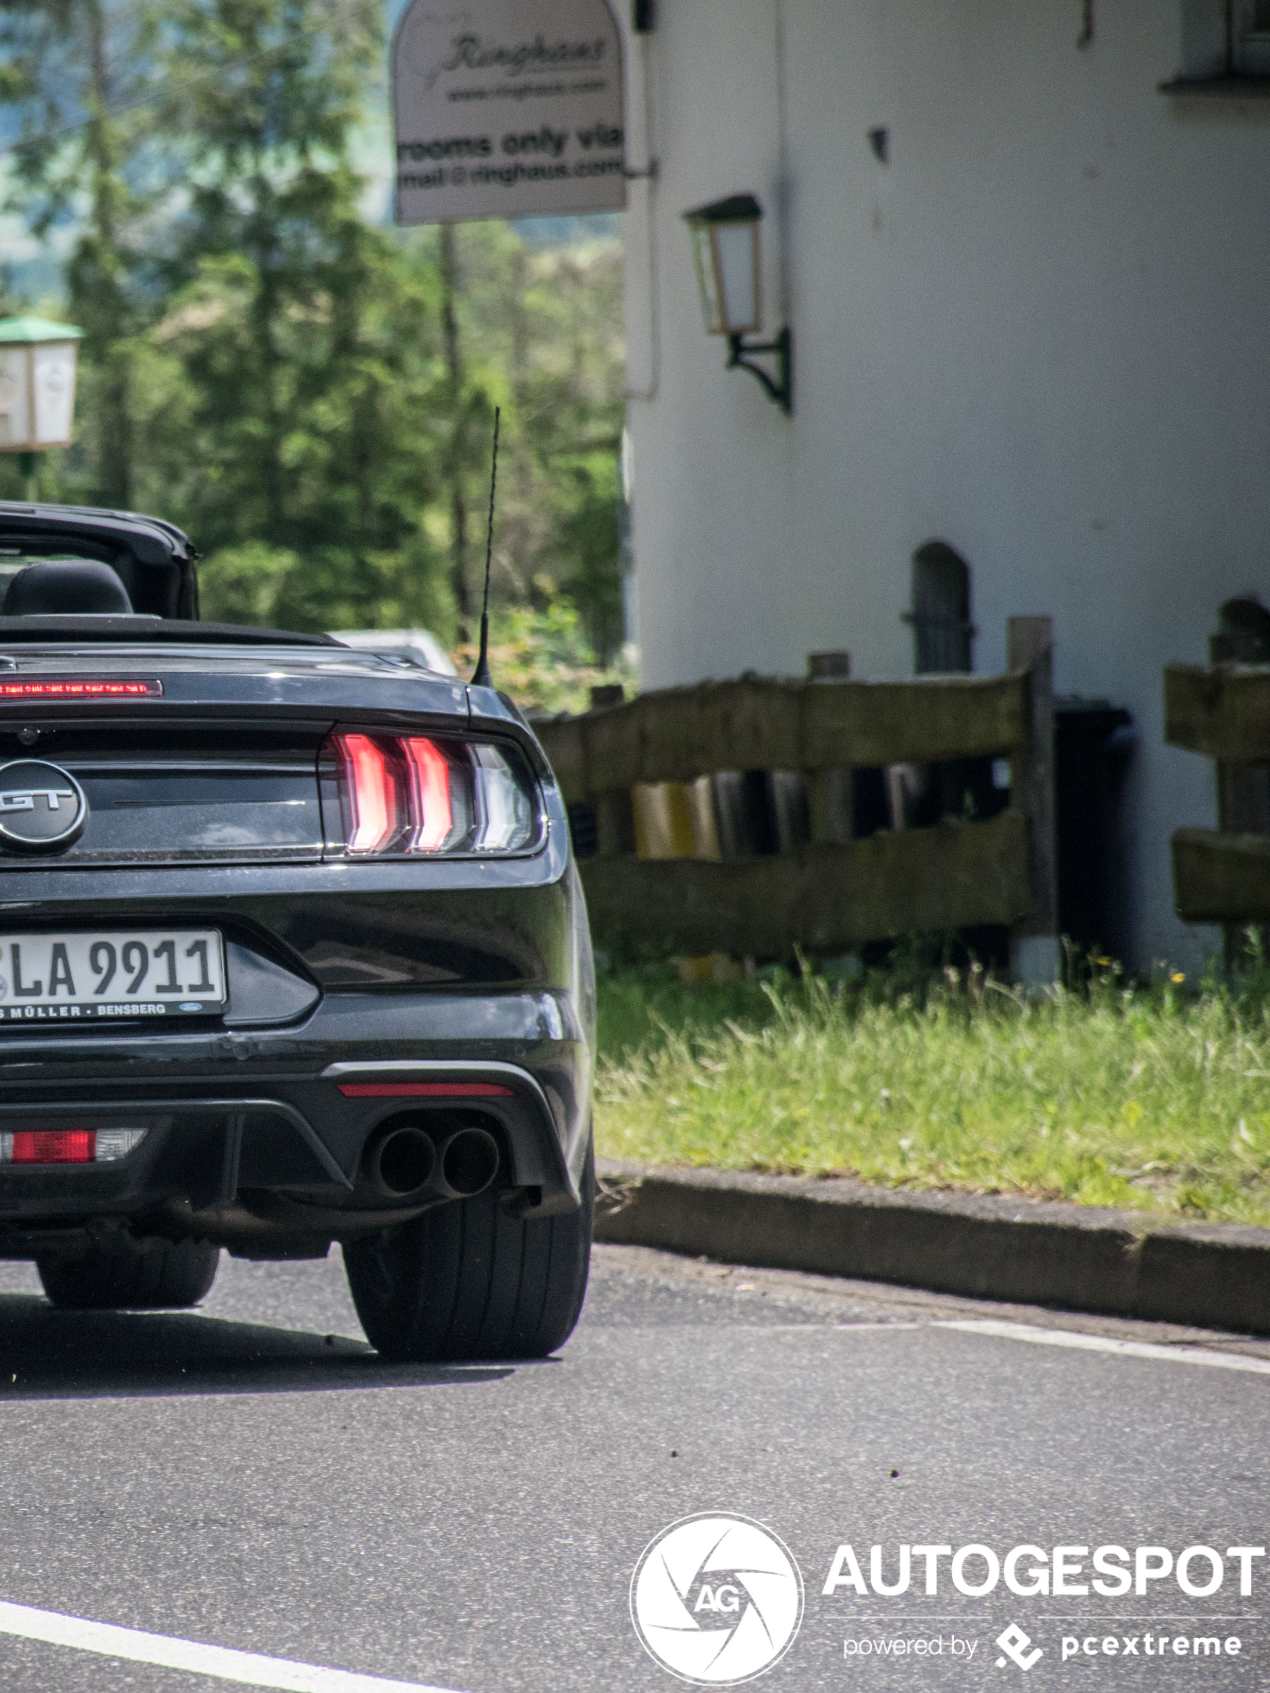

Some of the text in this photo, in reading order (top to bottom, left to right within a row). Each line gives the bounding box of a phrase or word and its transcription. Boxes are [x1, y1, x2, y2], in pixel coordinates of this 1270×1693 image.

[443, 31, 605, 77] Ringhaus
[397, 123, 623, 162] rooms only via
[11, 942, 76, 997] LA
[89, 938, 215, 995] 9911
[10, 1005, 80, 1019] MÜLLER
[97, 1003, 166, 1016] BENSBERG
